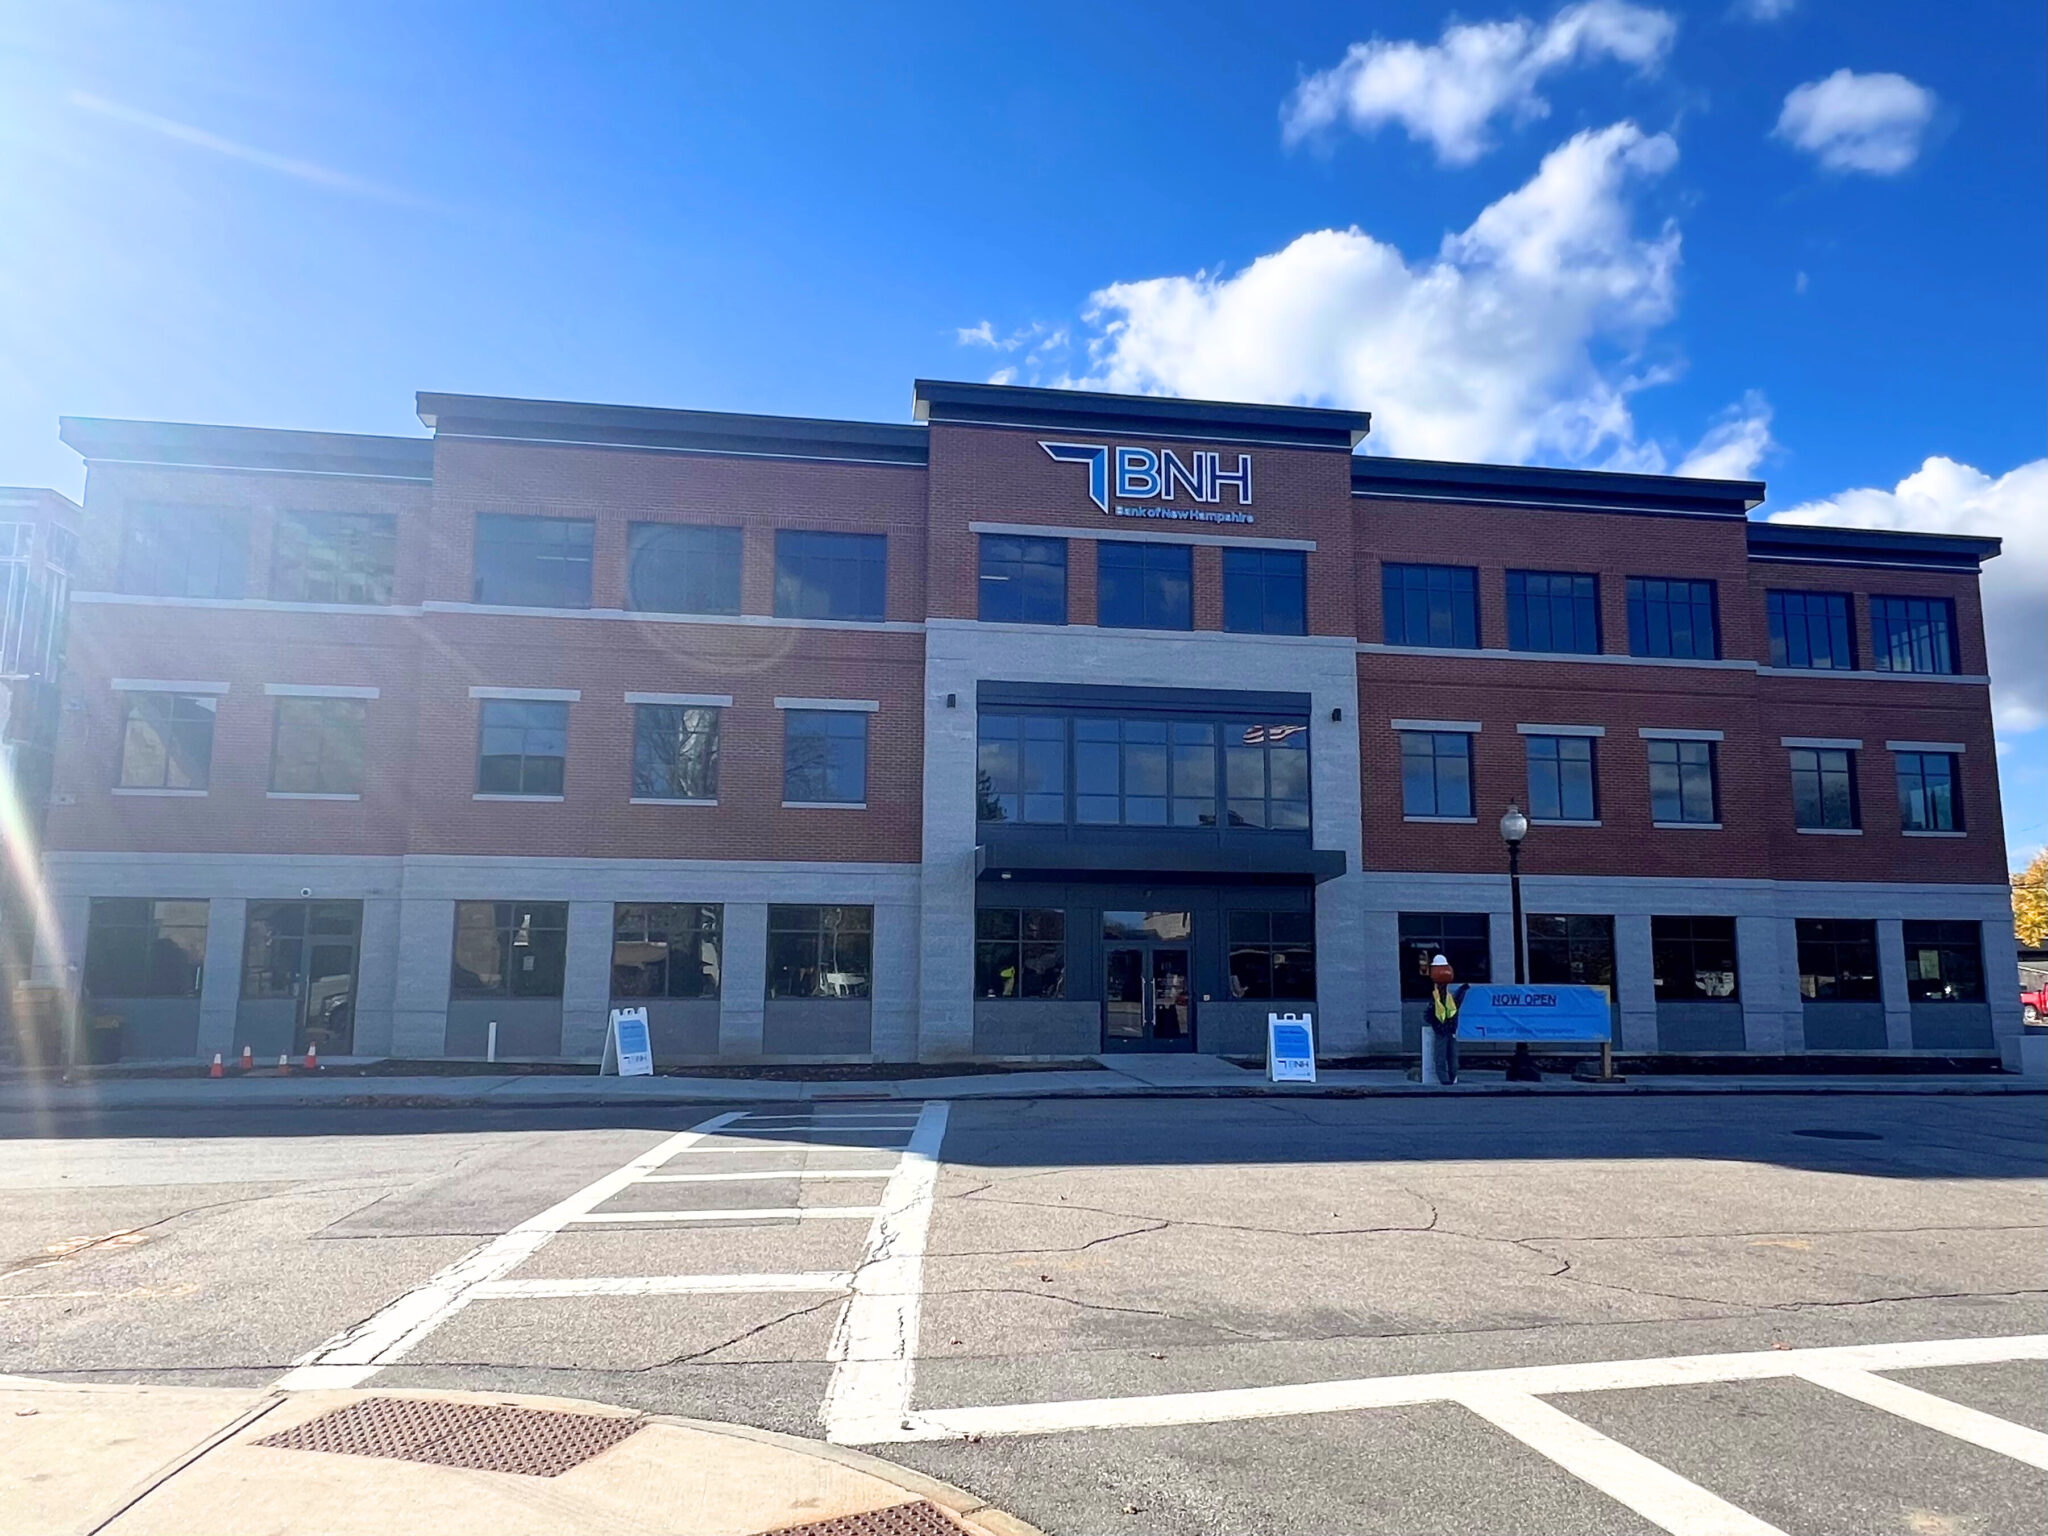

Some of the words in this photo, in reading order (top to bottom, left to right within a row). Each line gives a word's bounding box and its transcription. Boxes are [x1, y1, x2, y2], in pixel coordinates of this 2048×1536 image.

[1115, 446, 1252, 504] BNH
[1115, 506, 1147, 517] Bank
[1147, 507, 1161, 517] of
[1161, 508, 1189, 519] New
[1189, 509, 1255, 524] Hampshire
[1492, 993, 1521, 1006] NOW
[1525, 994, 1557, 1006] OPEN
